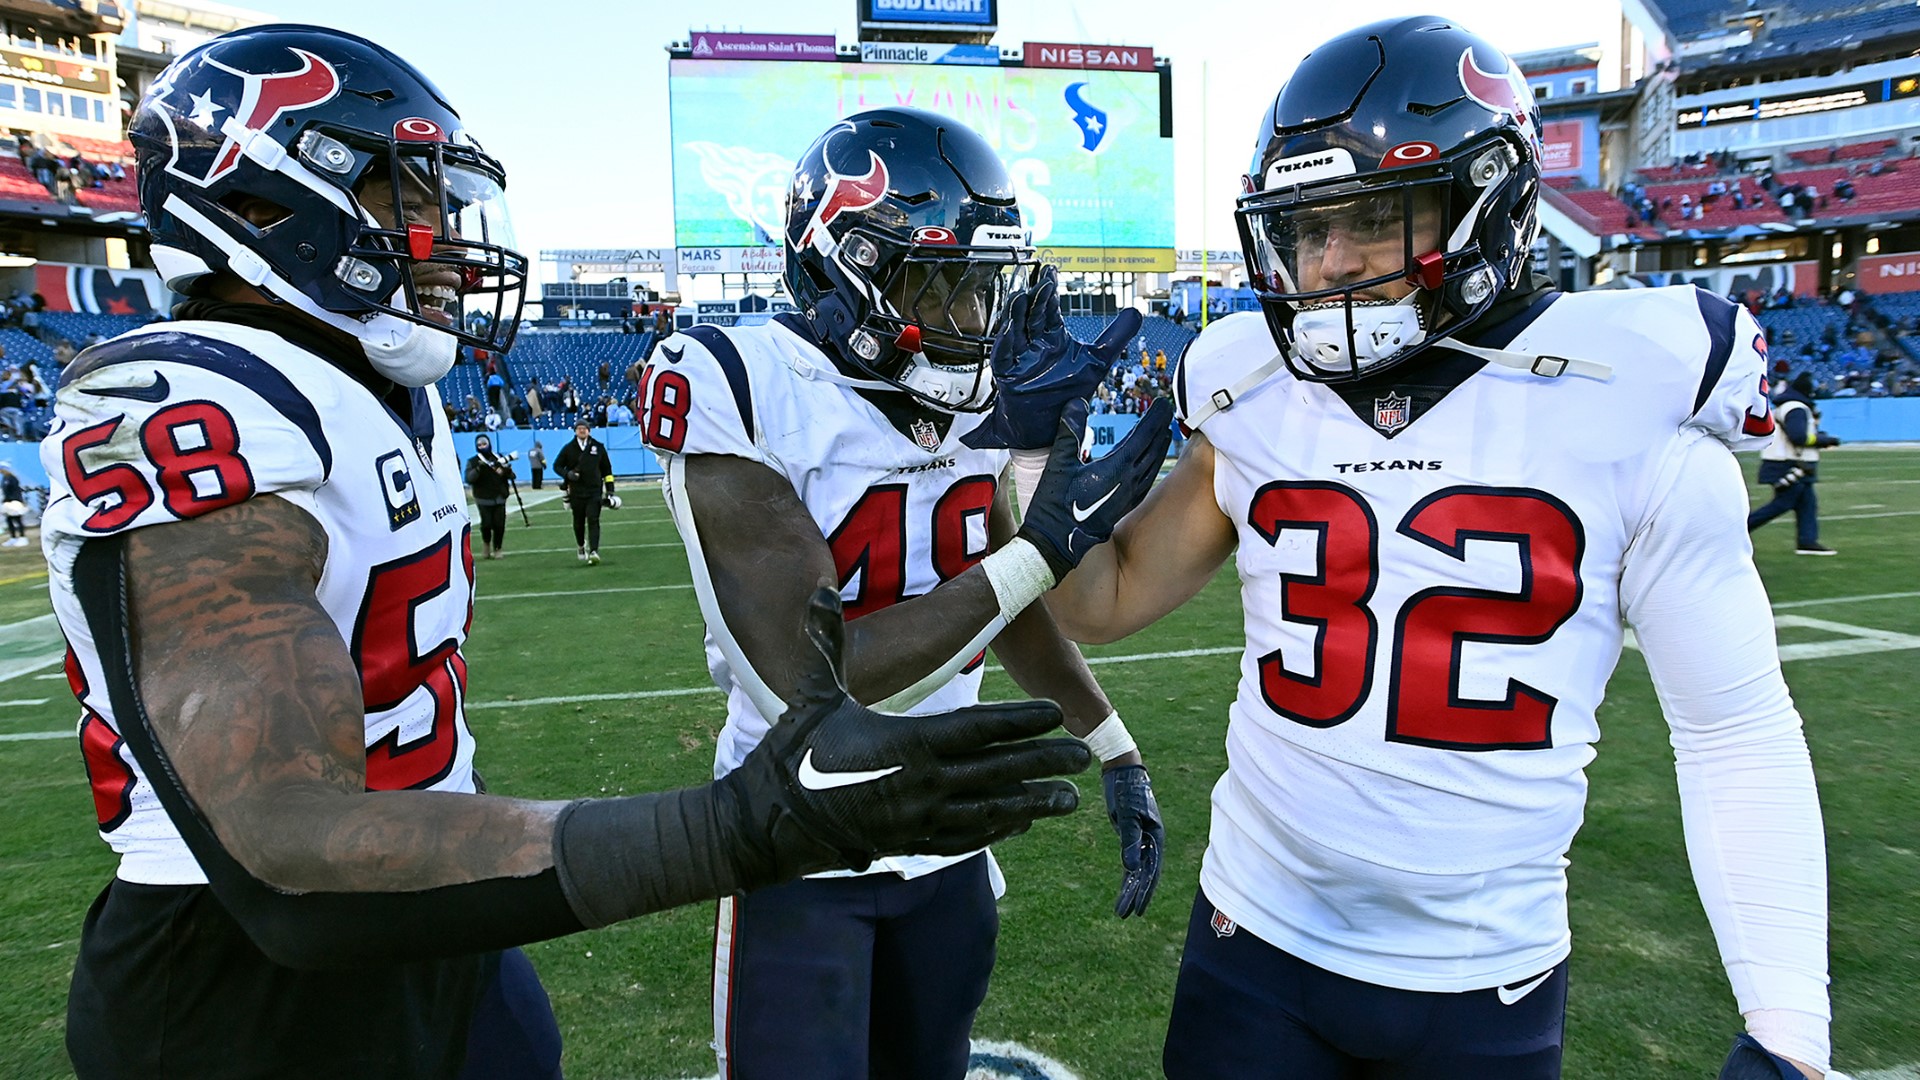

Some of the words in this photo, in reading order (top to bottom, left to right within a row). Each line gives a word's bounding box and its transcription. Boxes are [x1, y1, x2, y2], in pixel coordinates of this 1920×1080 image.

[715, 40, 767, 52] Ascension
[768, 41, 794, 52] Saint
[795, 42, 834, 53] Thomas
[864, 44, 928, 61] Pinnacle
[1040, 47, 1138, 66] NISSAN
[1275, 156, 1334, 174] TEXANS
[681, 249, 722, 261] MARS
[1037, 248, 1073, 269] Kroger
[1077, 256, 1100, 264] FRESH
[1118, 256, 1156, 264] EVERYONE
[682, 263, 716, 272] Petcare
[1879, 261, 1920, 278] NI
[1379, 409, 1404, 426] NFL
[62, 399, 255, 533] 58
[898, 458, 956, 474] TEXANS
[1333, 459, 1443, 474] TEXANS
[382, 454, 415, 509] C
[432, 504, 458, 523] TEXANS
[1247, 480, 1586, 752] 32
[350, 522, 475, 793] 5
[1214, 912, 1233, 932] NFL
